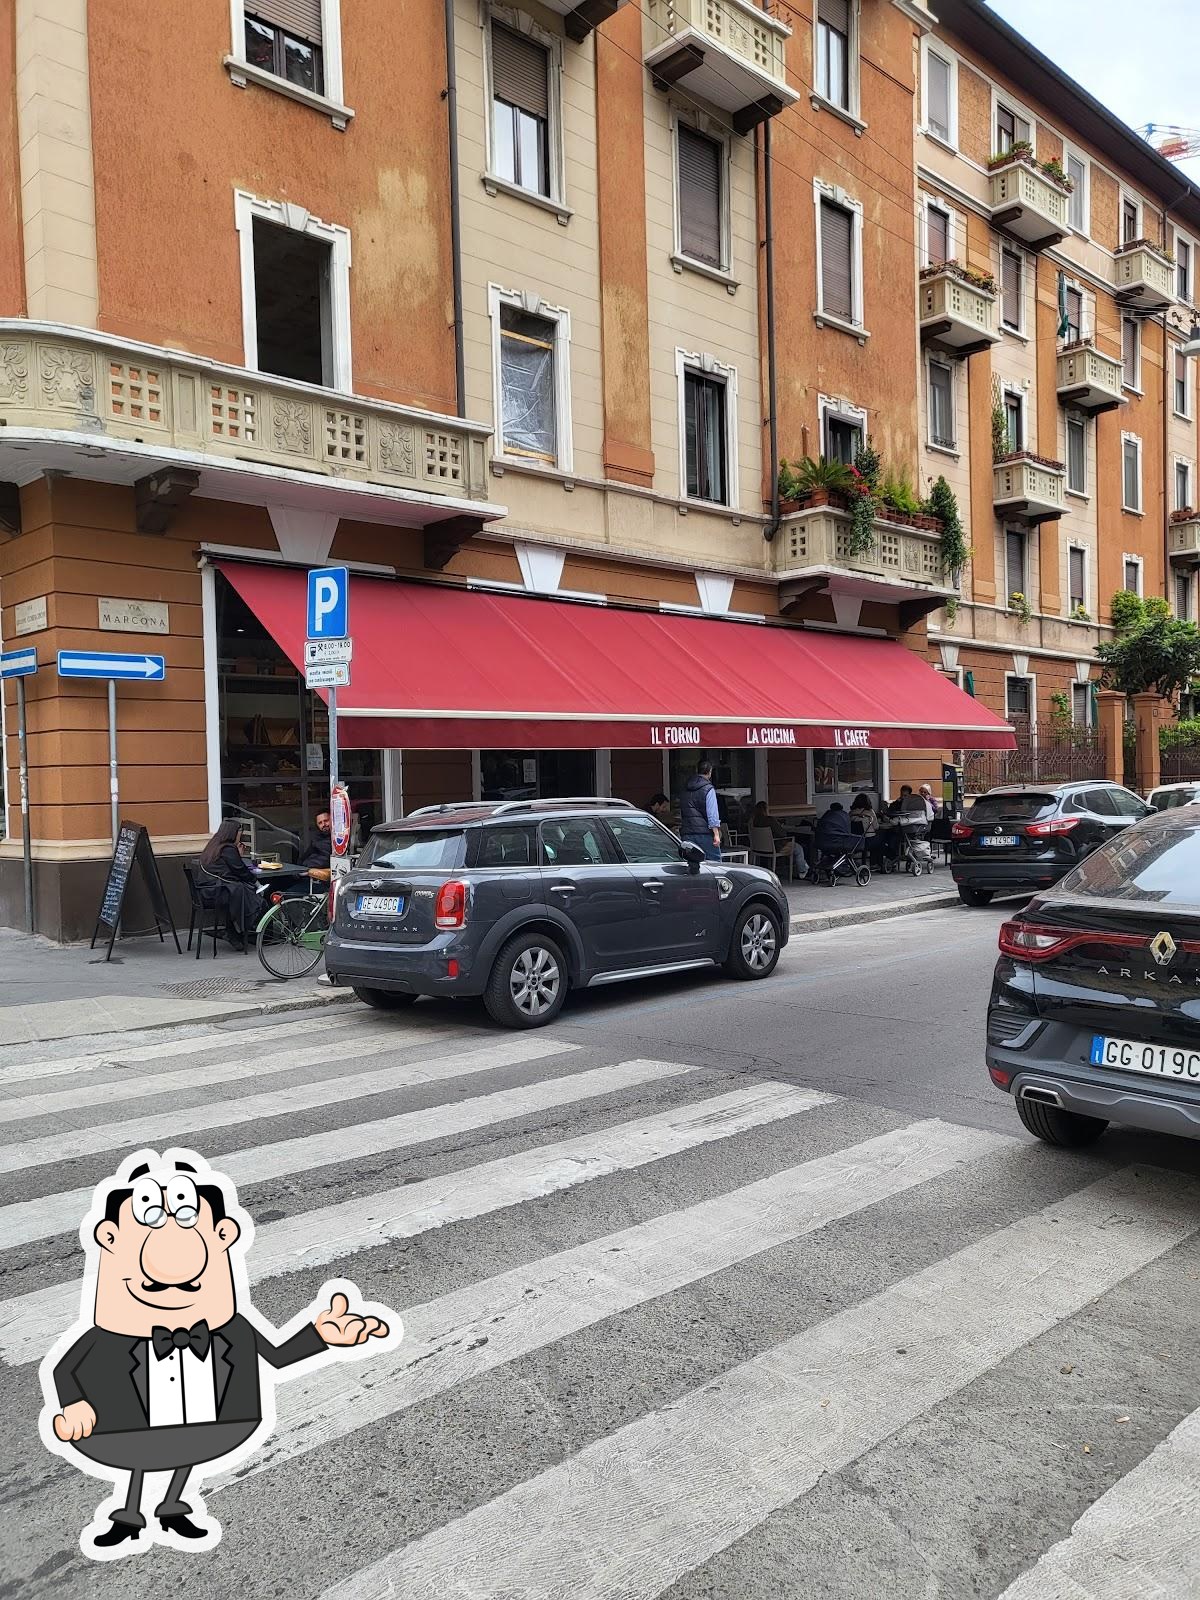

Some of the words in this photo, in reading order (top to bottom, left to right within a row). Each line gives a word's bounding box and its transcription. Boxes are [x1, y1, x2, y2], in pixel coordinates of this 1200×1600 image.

[127, 603, 141, 612] VIA
[315, 576, 339, 632] P
[102, 614, 166, 627] MARCONA
[651, 727, 662, 745] IL
[664, 726, 700, 745] FORNO
[746, 728, 759, 744] LA
[760, 728, 796, 745] CUCINA
[834, 729, 844, 746] IL
[944, 770, 951, 780] P
[362, 897, 373, 910] GE
[374, 897, 398, 911] 449CG
[1106, 1041, 1133, 1067] GG
